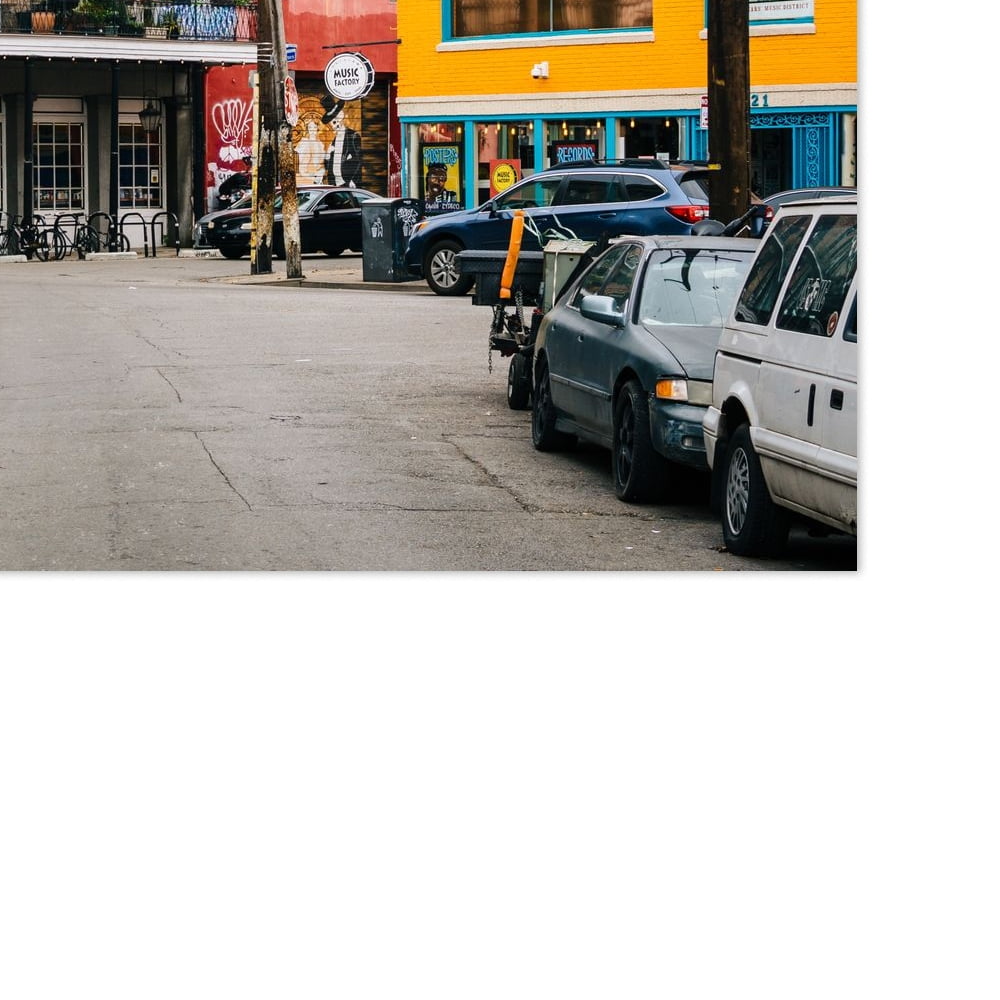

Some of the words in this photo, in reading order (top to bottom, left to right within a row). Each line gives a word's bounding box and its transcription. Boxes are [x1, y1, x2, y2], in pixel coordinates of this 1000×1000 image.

[333, 68, 359, 79] MUSIC
[334, 79, 360, 87] FACTORY
[751, 94, 769, 107] 21
[557, 146, 595, 162] RECORDS
